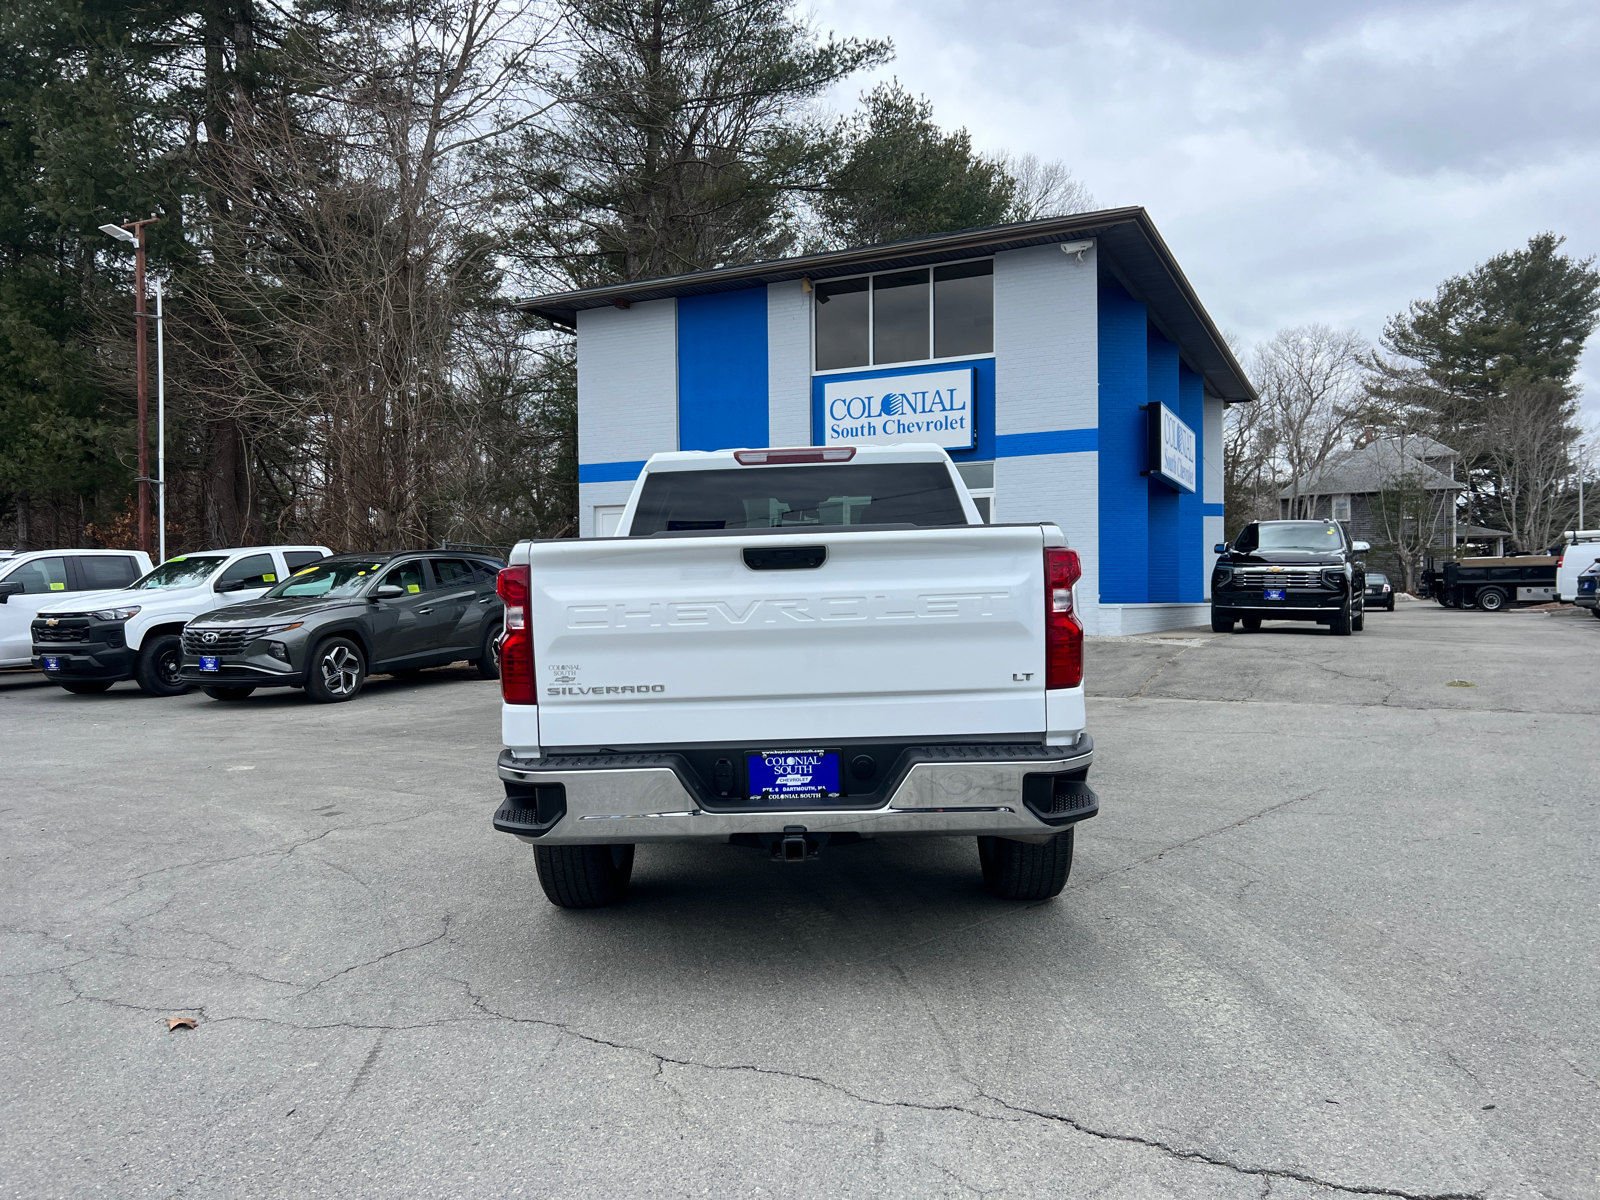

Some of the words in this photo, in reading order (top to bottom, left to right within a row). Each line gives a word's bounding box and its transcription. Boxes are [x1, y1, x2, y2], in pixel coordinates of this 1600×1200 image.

[829, 388, 966, 421] COLONIAL
[830, 421, 877, 439] South
[882, 415, 966, 436] Chevrolet
[566, 591, 1010, 629] CHEVROLET
[1012, 672, 1035, 682] LT
[547, 684, 665, 696] SILVERADO
[765, 756, 821, 766] COLONIAL
[774, 765, 813, 775] SOUTH
